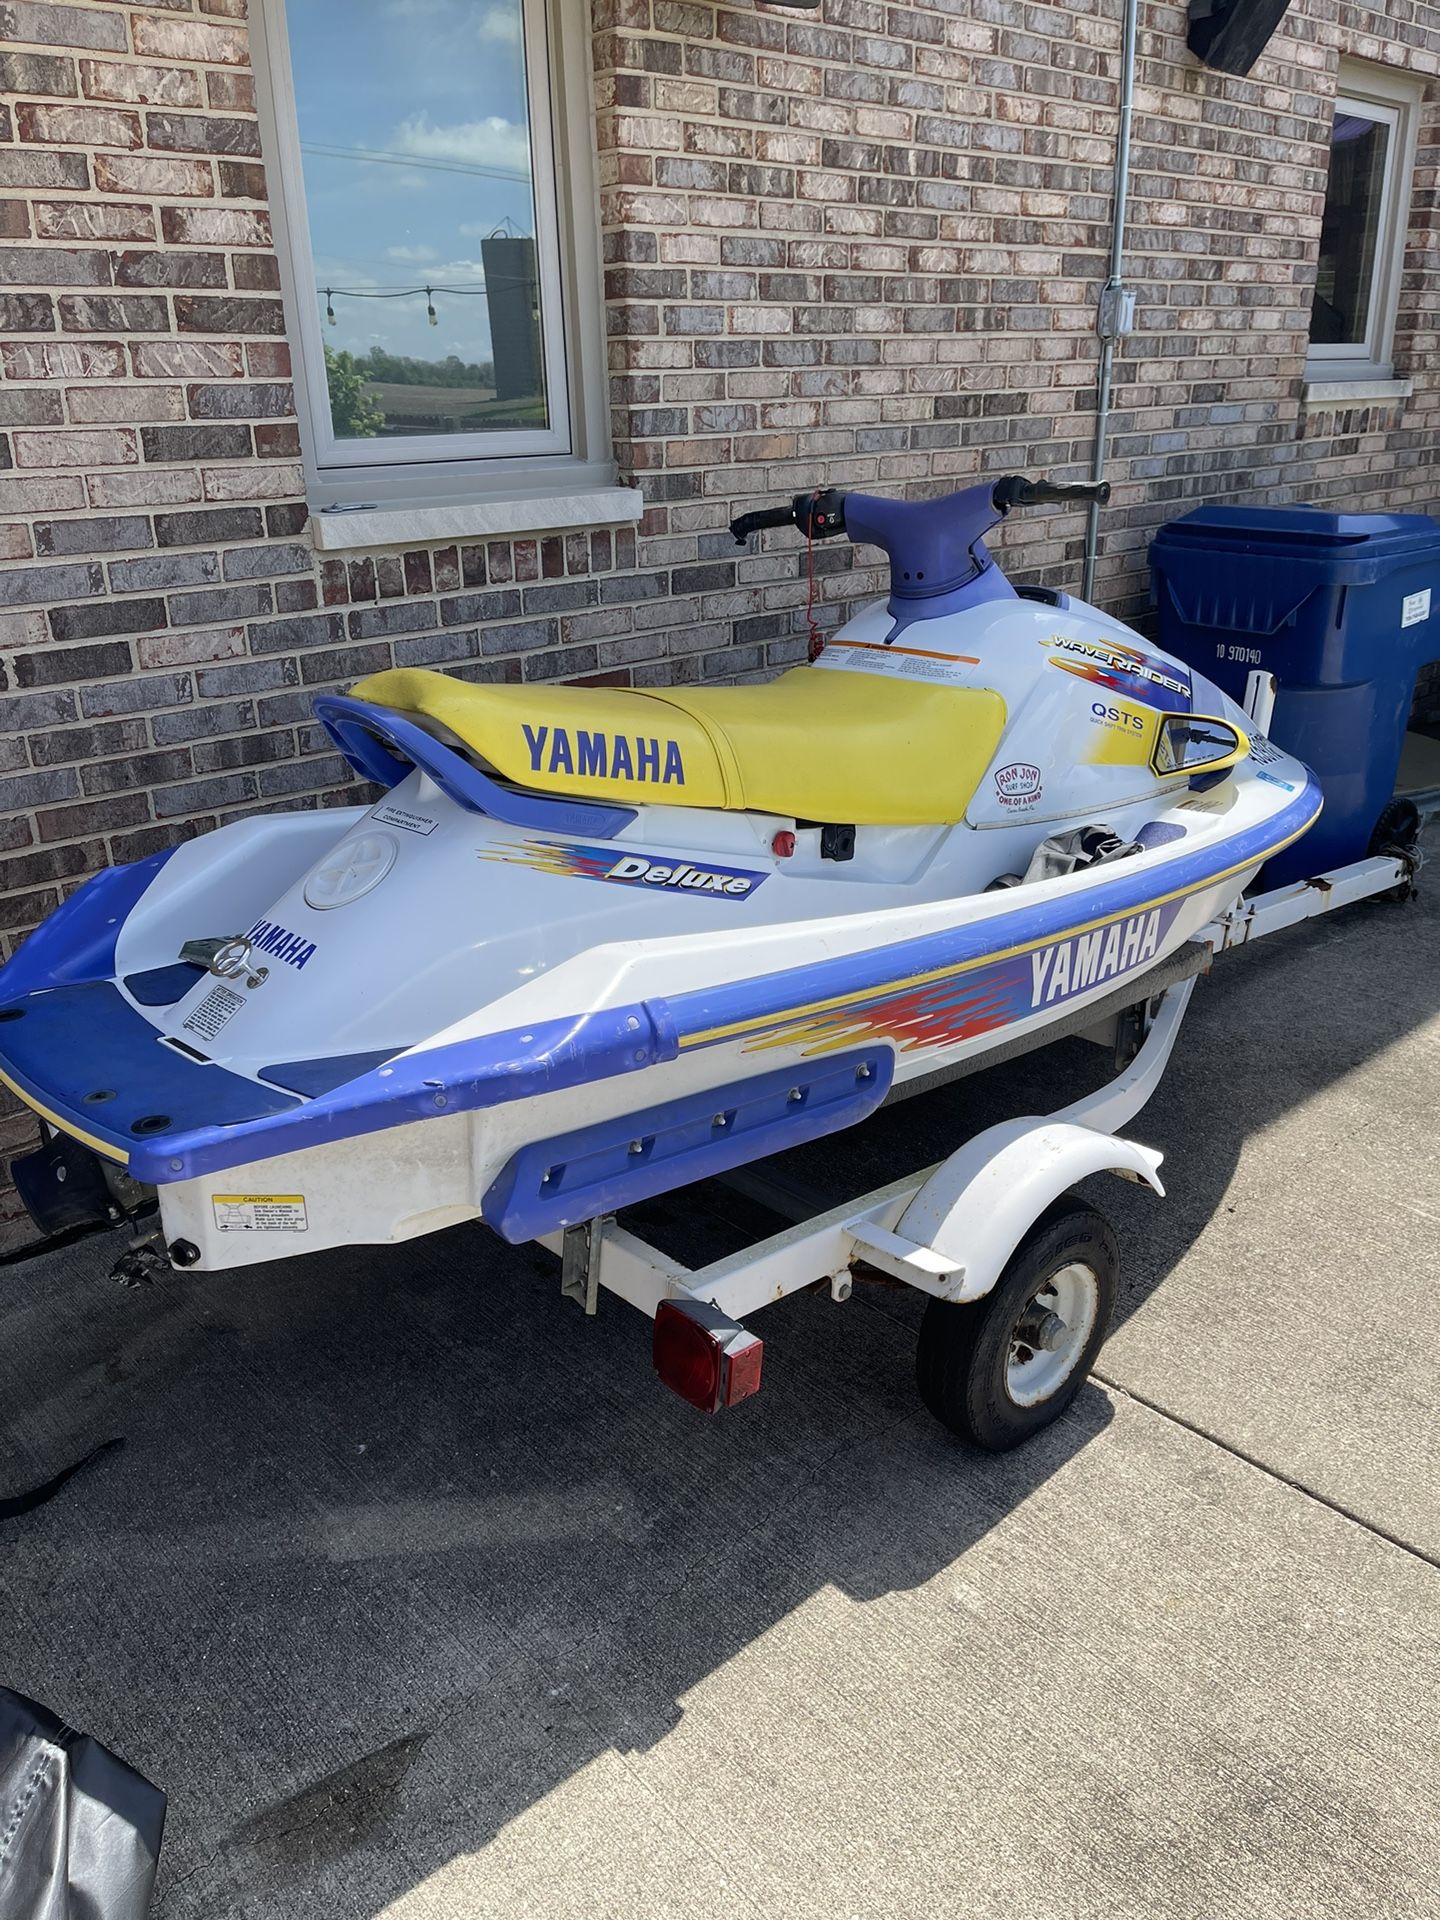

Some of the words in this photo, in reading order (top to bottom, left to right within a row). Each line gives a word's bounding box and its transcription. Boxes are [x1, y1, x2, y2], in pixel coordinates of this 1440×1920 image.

[1053, 633, 1192, 699] WAVERAIDER
[1228, 645, 1262, 665] 970140
[1091, 702, 1144, 730] QSTS
[521, 723, 686, 785] YAMAHA
[999, 767, 1018, 786] RON
[1019, 767, 1038, 781] JON
[1005, 782, 1018, 791] SURF
[1019, 781, 1034, 790] SHOP
[604, 855, 753, 895] Deluxe
[245, 919, 318, 971] YAMAHA
[1031, 908, 1161, 1008] YAMAHA
